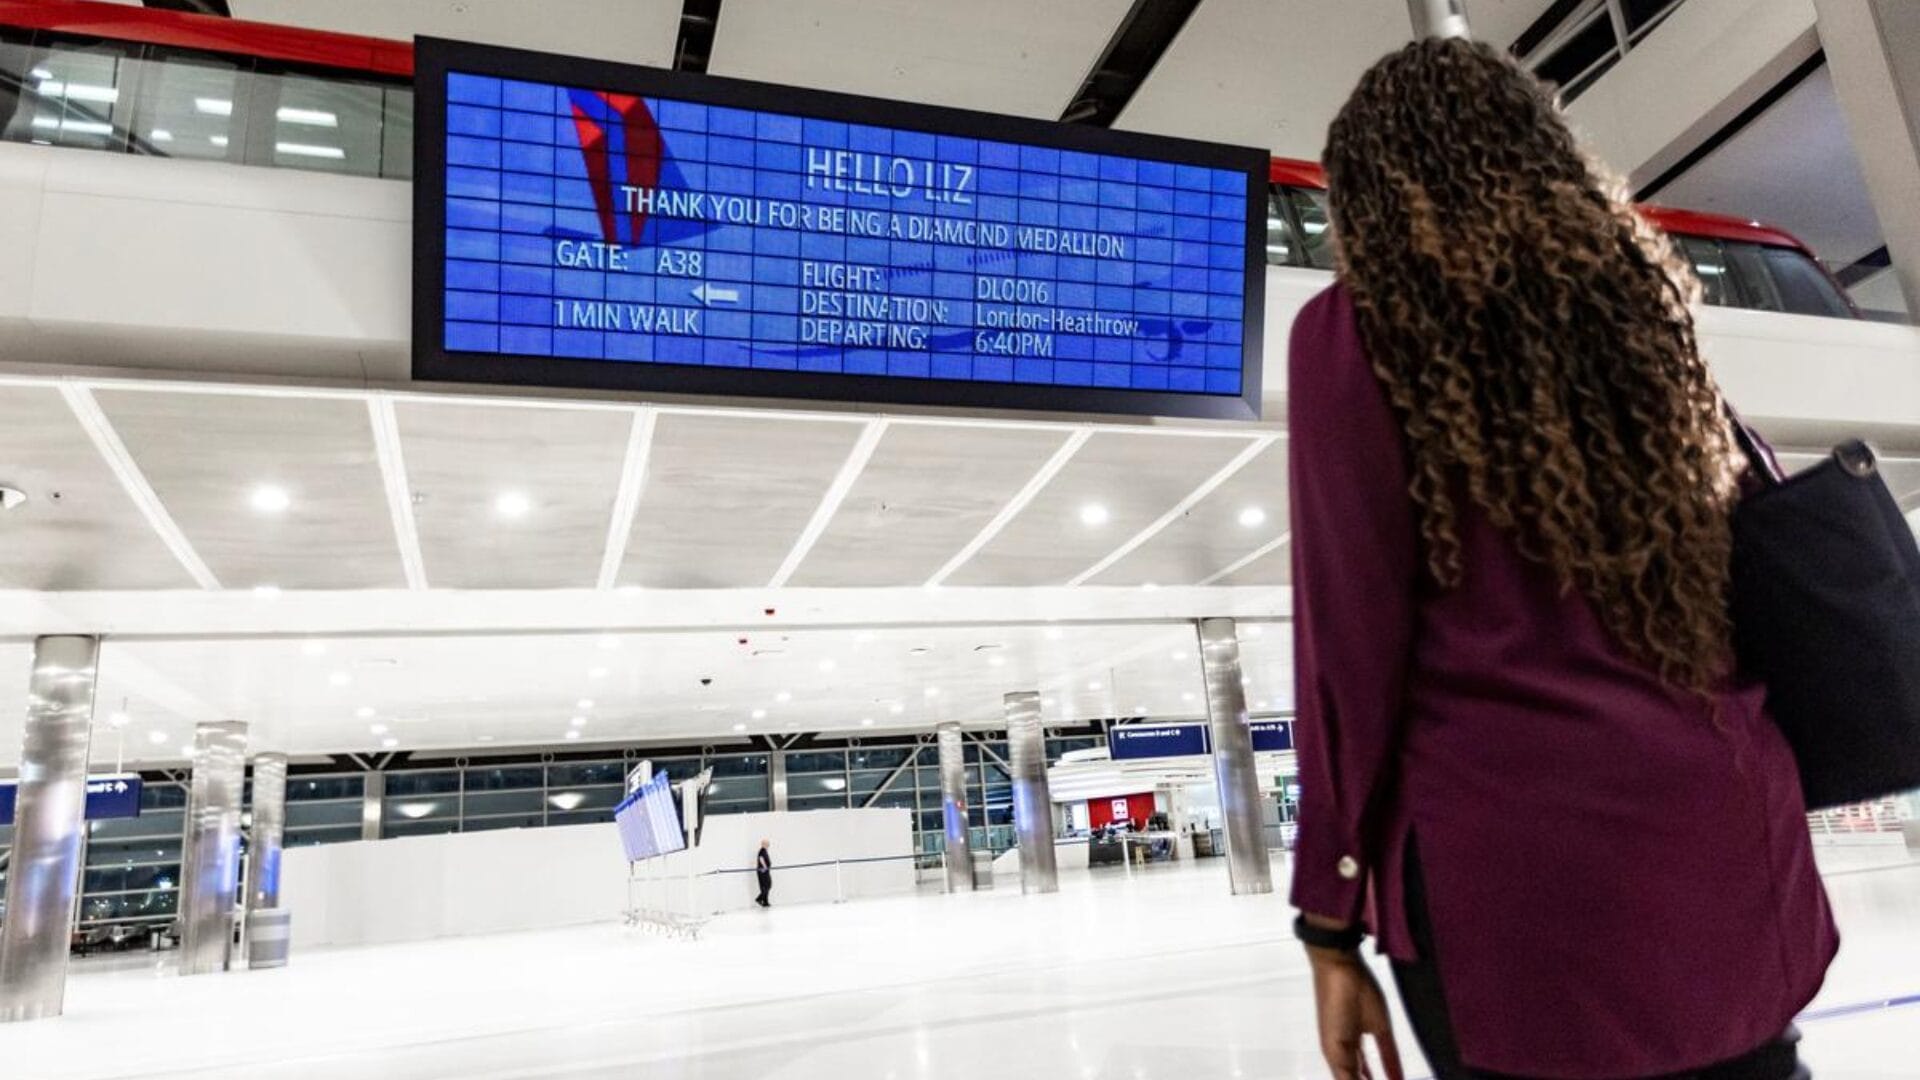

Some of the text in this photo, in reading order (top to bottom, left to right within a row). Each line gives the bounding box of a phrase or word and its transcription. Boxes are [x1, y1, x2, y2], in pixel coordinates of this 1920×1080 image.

[808, 148, 973, 204] HELLO LIZ
[621, 185, 1126, 258] THANK YOU FOR BEING A DIAMOND MEDALLION
[556, 240, 703, 276] GATE: A38
[802, 262, 1049, 304] FLIGHT: DL0016
[554, 300, 700, 335] 1 MIN WALK
[802, 291, 1138, 335] DESTINATION: London-Heathrow
[802, 318, 1052, 358] DEPARTING: 6:40PM
